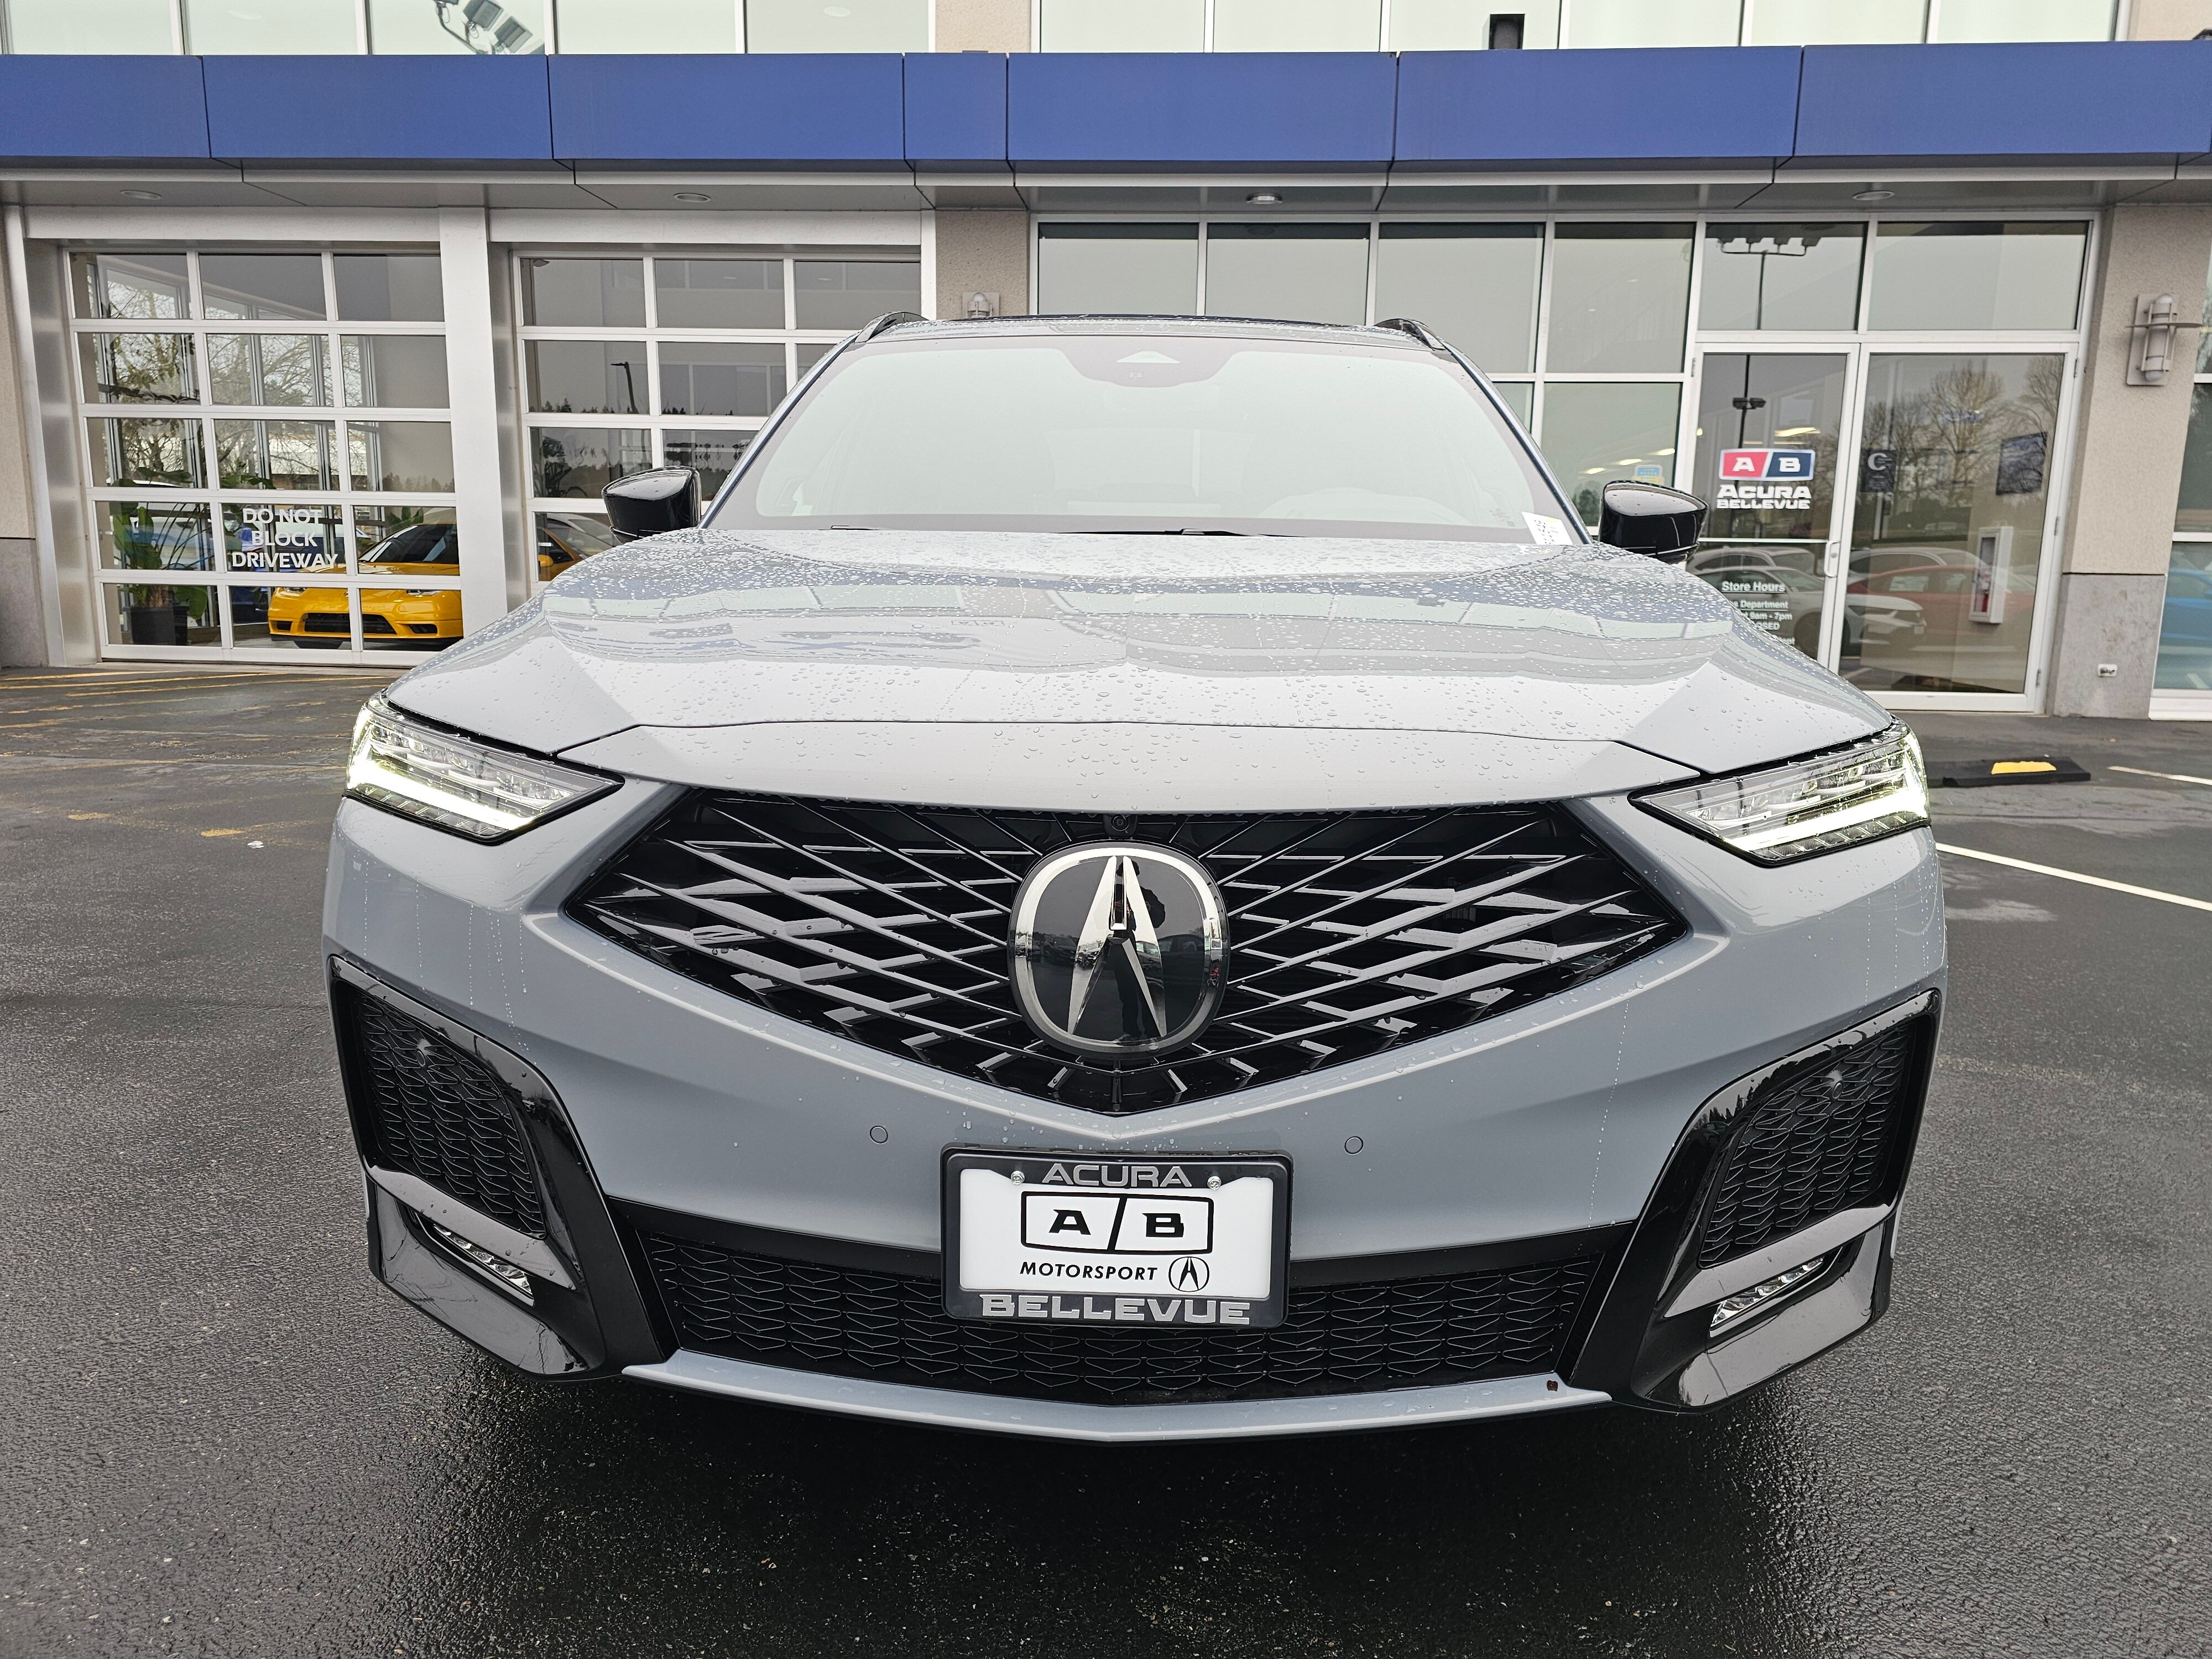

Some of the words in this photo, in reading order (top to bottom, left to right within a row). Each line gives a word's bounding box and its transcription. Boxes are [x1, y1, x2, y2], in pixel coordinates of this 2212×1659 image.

[1732, 457, 1755, 472] A
[1778, 457, 1801, 472] B
[1717, 484, 1812, 499] ACURA
[1716, 498, 1811, 509] BELLEVUE
[242, 508, 274, 524] DO
[279, 508, 322, 524] NOT
[251, 530, 318, 547] BLOCK
[232, 551, 338, 568] DRIVEWAY
[1721, 581, 1751, 592] Store
[1752, 581, 1786, 592] Hours
[1740, 599, 1789, 609] Department
[1773, 612, 1793, 622] 7pm
[1042, 1163, 1192, 1188] ACURA
[1048, 1209, 1092, 1235] A
[1141, 1213, 1185, 1238] B
[1020, 1261, 1158, 1281] MOTORSPORT
[978, 1293, 1250, 1326] BELLEVUE
